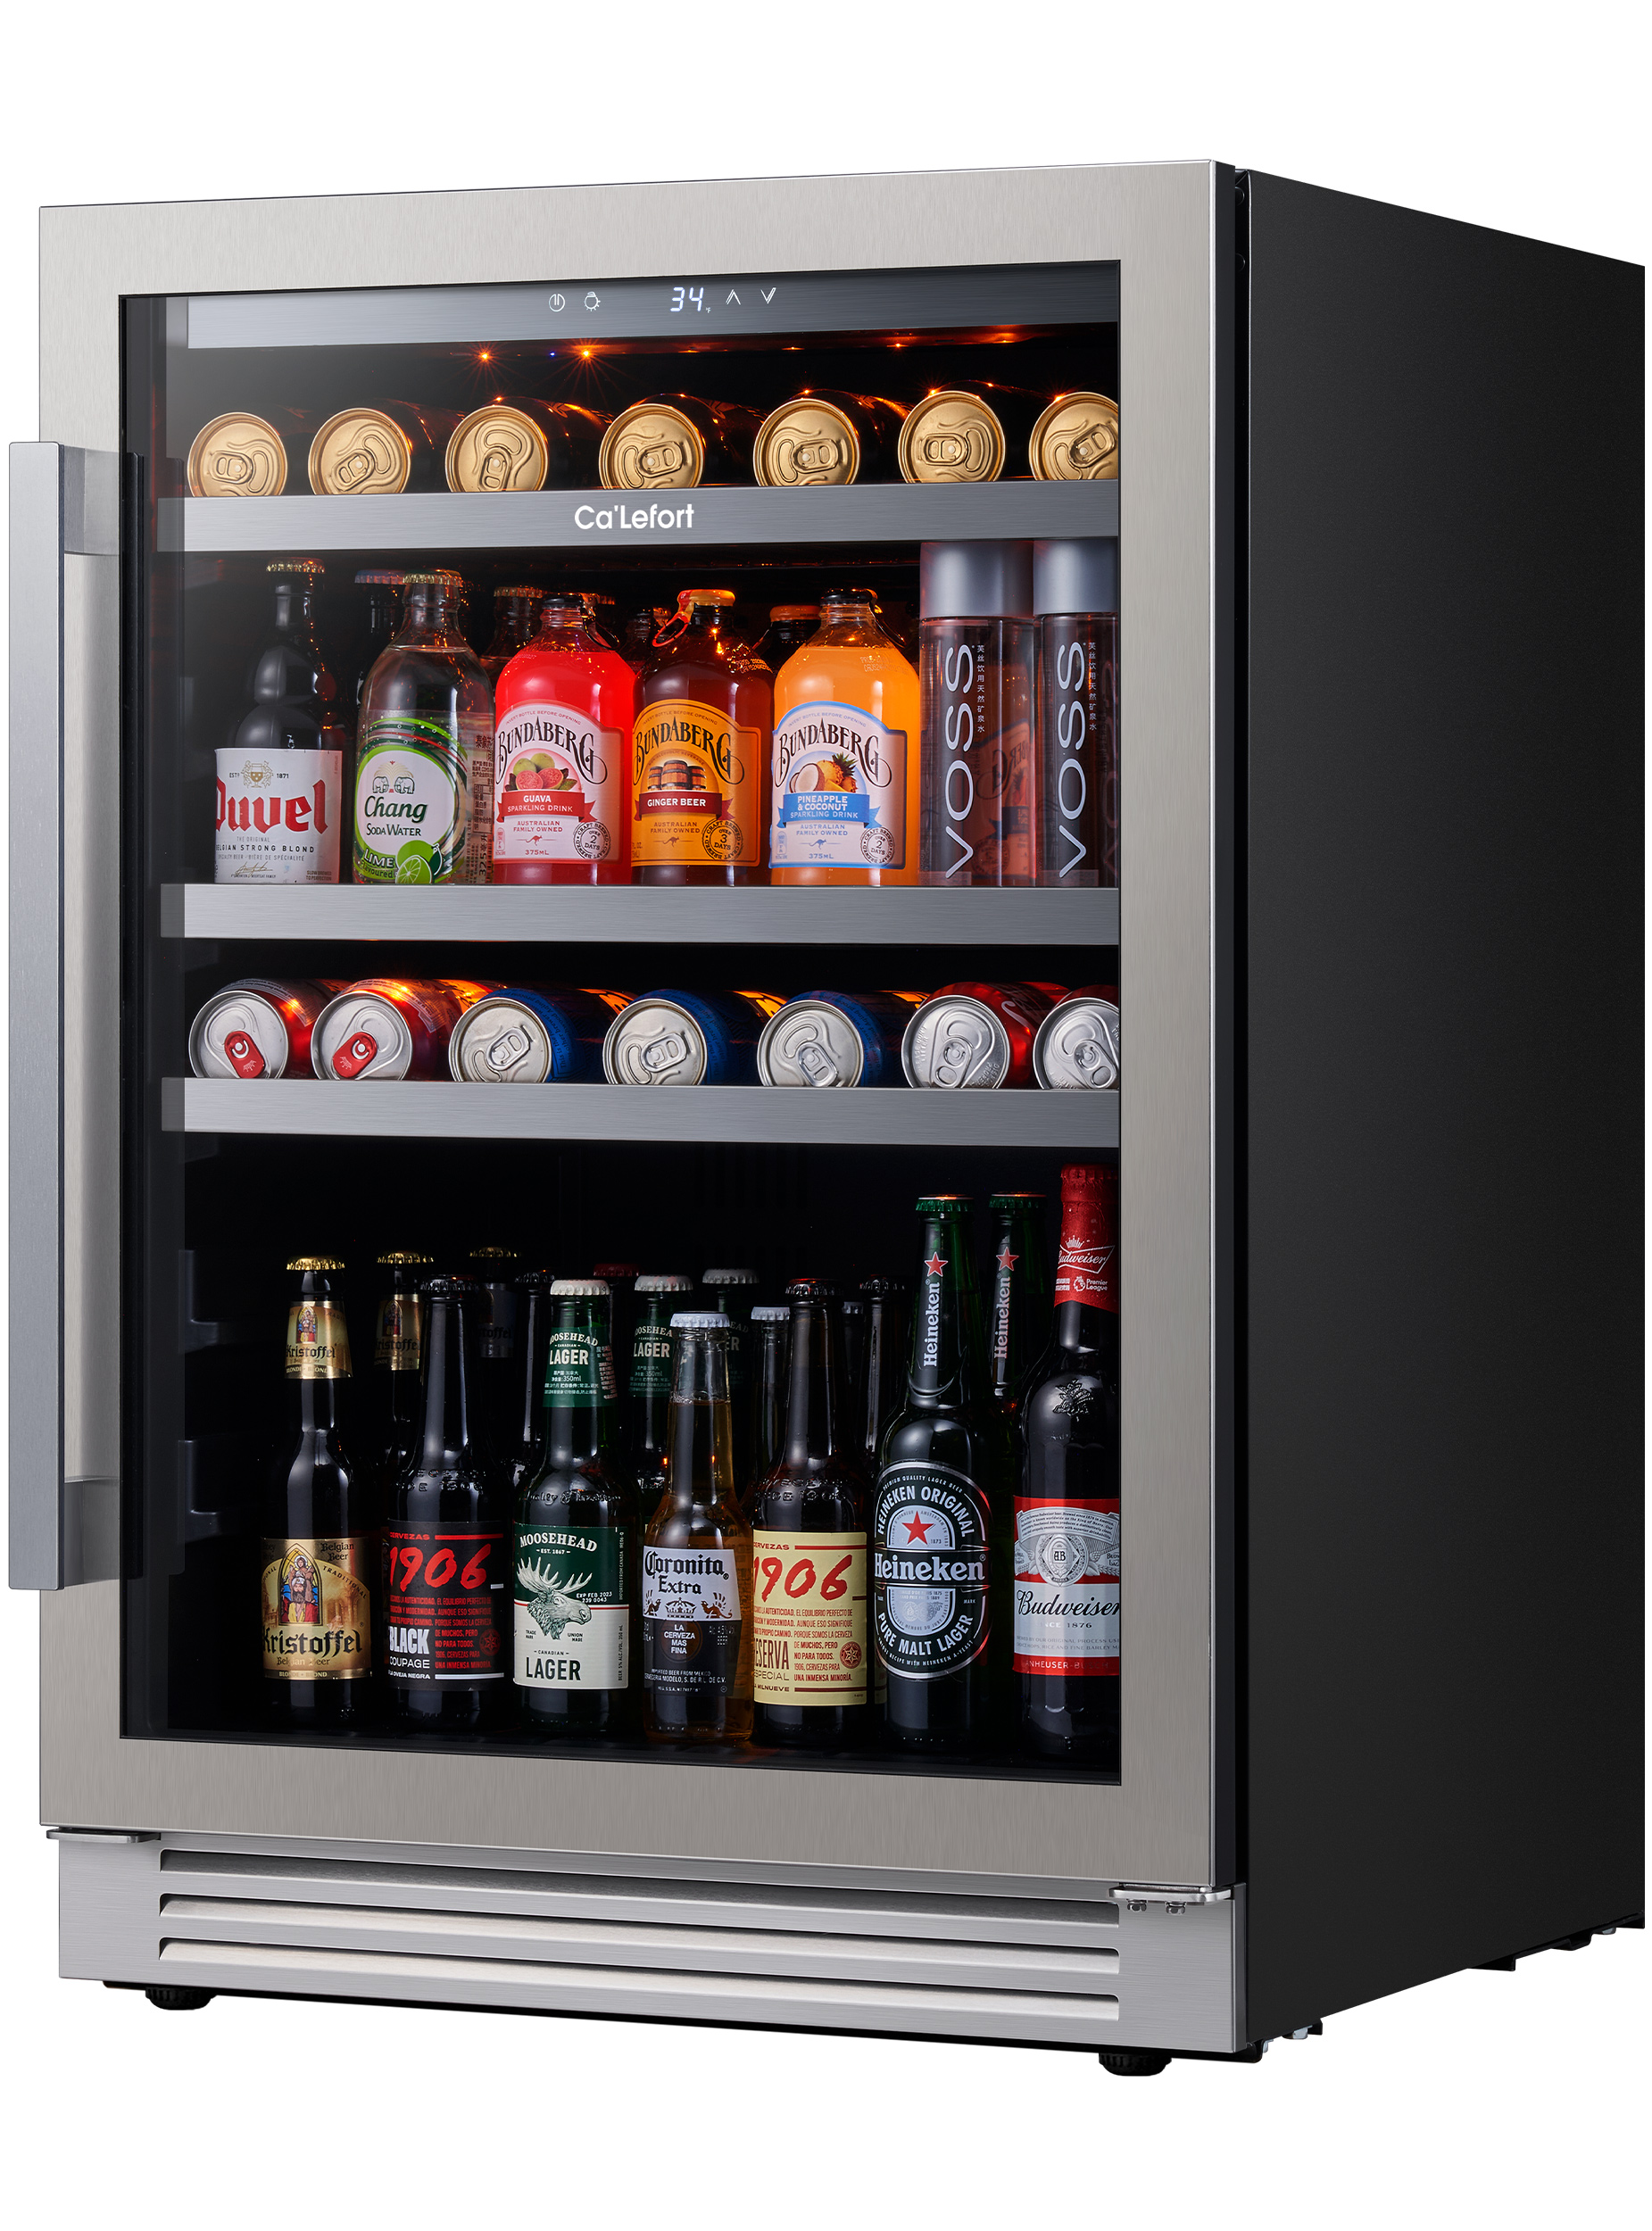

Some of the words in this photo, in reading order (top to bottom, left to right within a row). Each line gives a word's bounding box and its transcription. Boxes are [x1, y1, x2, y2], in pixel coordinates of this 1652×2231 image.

[670, 287, 703, 311] 34
[575, 504, 694, 529] Ca'Lefort
[559, 714, 581, 725] OPENING
[694, 713, 718, 725] OPENING
[843, 715, 867, 727] OPENING
[496, 716, 607, 784] BUNDABERG
[633, 716, 744, 785] BUNDABERG
[775, 717, 892, 787] BUNDABERG
[945, 644, 974, 878] VOSS
[1057, 642, 1086, 878] VOSS
[524, 795, 552, 803] GUAVA
[647, 799, 677, 807] GINGER
[680, 799, 706, 807] BEER
[798, 795, 848, 803] PINEAPPLE
[364, 795, 428, 824] Chang
[386, 824, 421, 836] WATER
[720, 834, 726, 842] 3
[585, 842, 600, 850] DAYS
[590, 835, 596, 843] 2
[876, 841, 882, 849] 2
[363, 848, 394, 868] LIME
[360, 860, 394, 878] Flavoured
[924, 1282, 941, 1367] Heineken
[994, 1276, 1011, 1359] Heineken
[550, 1332, 598, 1347] OOSEHEAD
[635, 1325, 673, 1337] OOSEHEA
[286, 1344, 336, 1359] Kristoffel
[376, 1339, 420, 1351] ristoffel
[634, 1342, 670, 1357] LAGER
[550, 1349, 589, 1364] LAGER
[883, 1477, 901, 1490] PREMIUM
[928, 1476, 947, 1486] LAGER
[949, 1483, 963, 1493] BEER
[877, 1485, 916, 1535] HEINEKEN
[921, 1486, 975, 1537] ORIGINAL
[320, 1542, 354, 1552] Belgian
[519, 1532, 597, 1552] MOOSEHEAD
[328, 1553, 348, 1561] Beer
[644, 1550, 725, 1579] Coronita
[390, 1543, 491, 1592] 1906
[875, 1553, 985, 1581] Heineken
[322, 1565, 367, 1600] TRADITIONAL
[658, 1575, 702, 1595] Extra
[1017, 1590, 1119, 1615] Budweiser
[802, 1609, 826, 1617] EQUILIBRIO
[797, 1620, 816, 1628] AUNQUE
[818, 1620, 826, 1628] ESO
[827, 1620, 852, 1628] SIGNIFIQUE
[389, 1626, 429, 1654] BLACK
[664, 1631, 695, 1639] CERVEZA
[794, 1630, 810, 1638] PORQUE
[812, 1630, 827, 1638] SOMOS
[834, 1630, 852, 1638] CERVEZA
[878, 1612, 897, 1647] PURE
[898, 1638, 932, 1655] MALT
[936, 1614, 974, 1652] LAGER
[263, 1628, 362, 1657] Kristoffel
[390, 1656, 430, 1669] COUPAGE
[754, 1638, 790, 1670] ESERVA
[889, 1654, 904, 1664] RECIPE
[923, 1656, 951, 1666] HEINEKEN
[527, 1657, 581, 1680] LAGER
